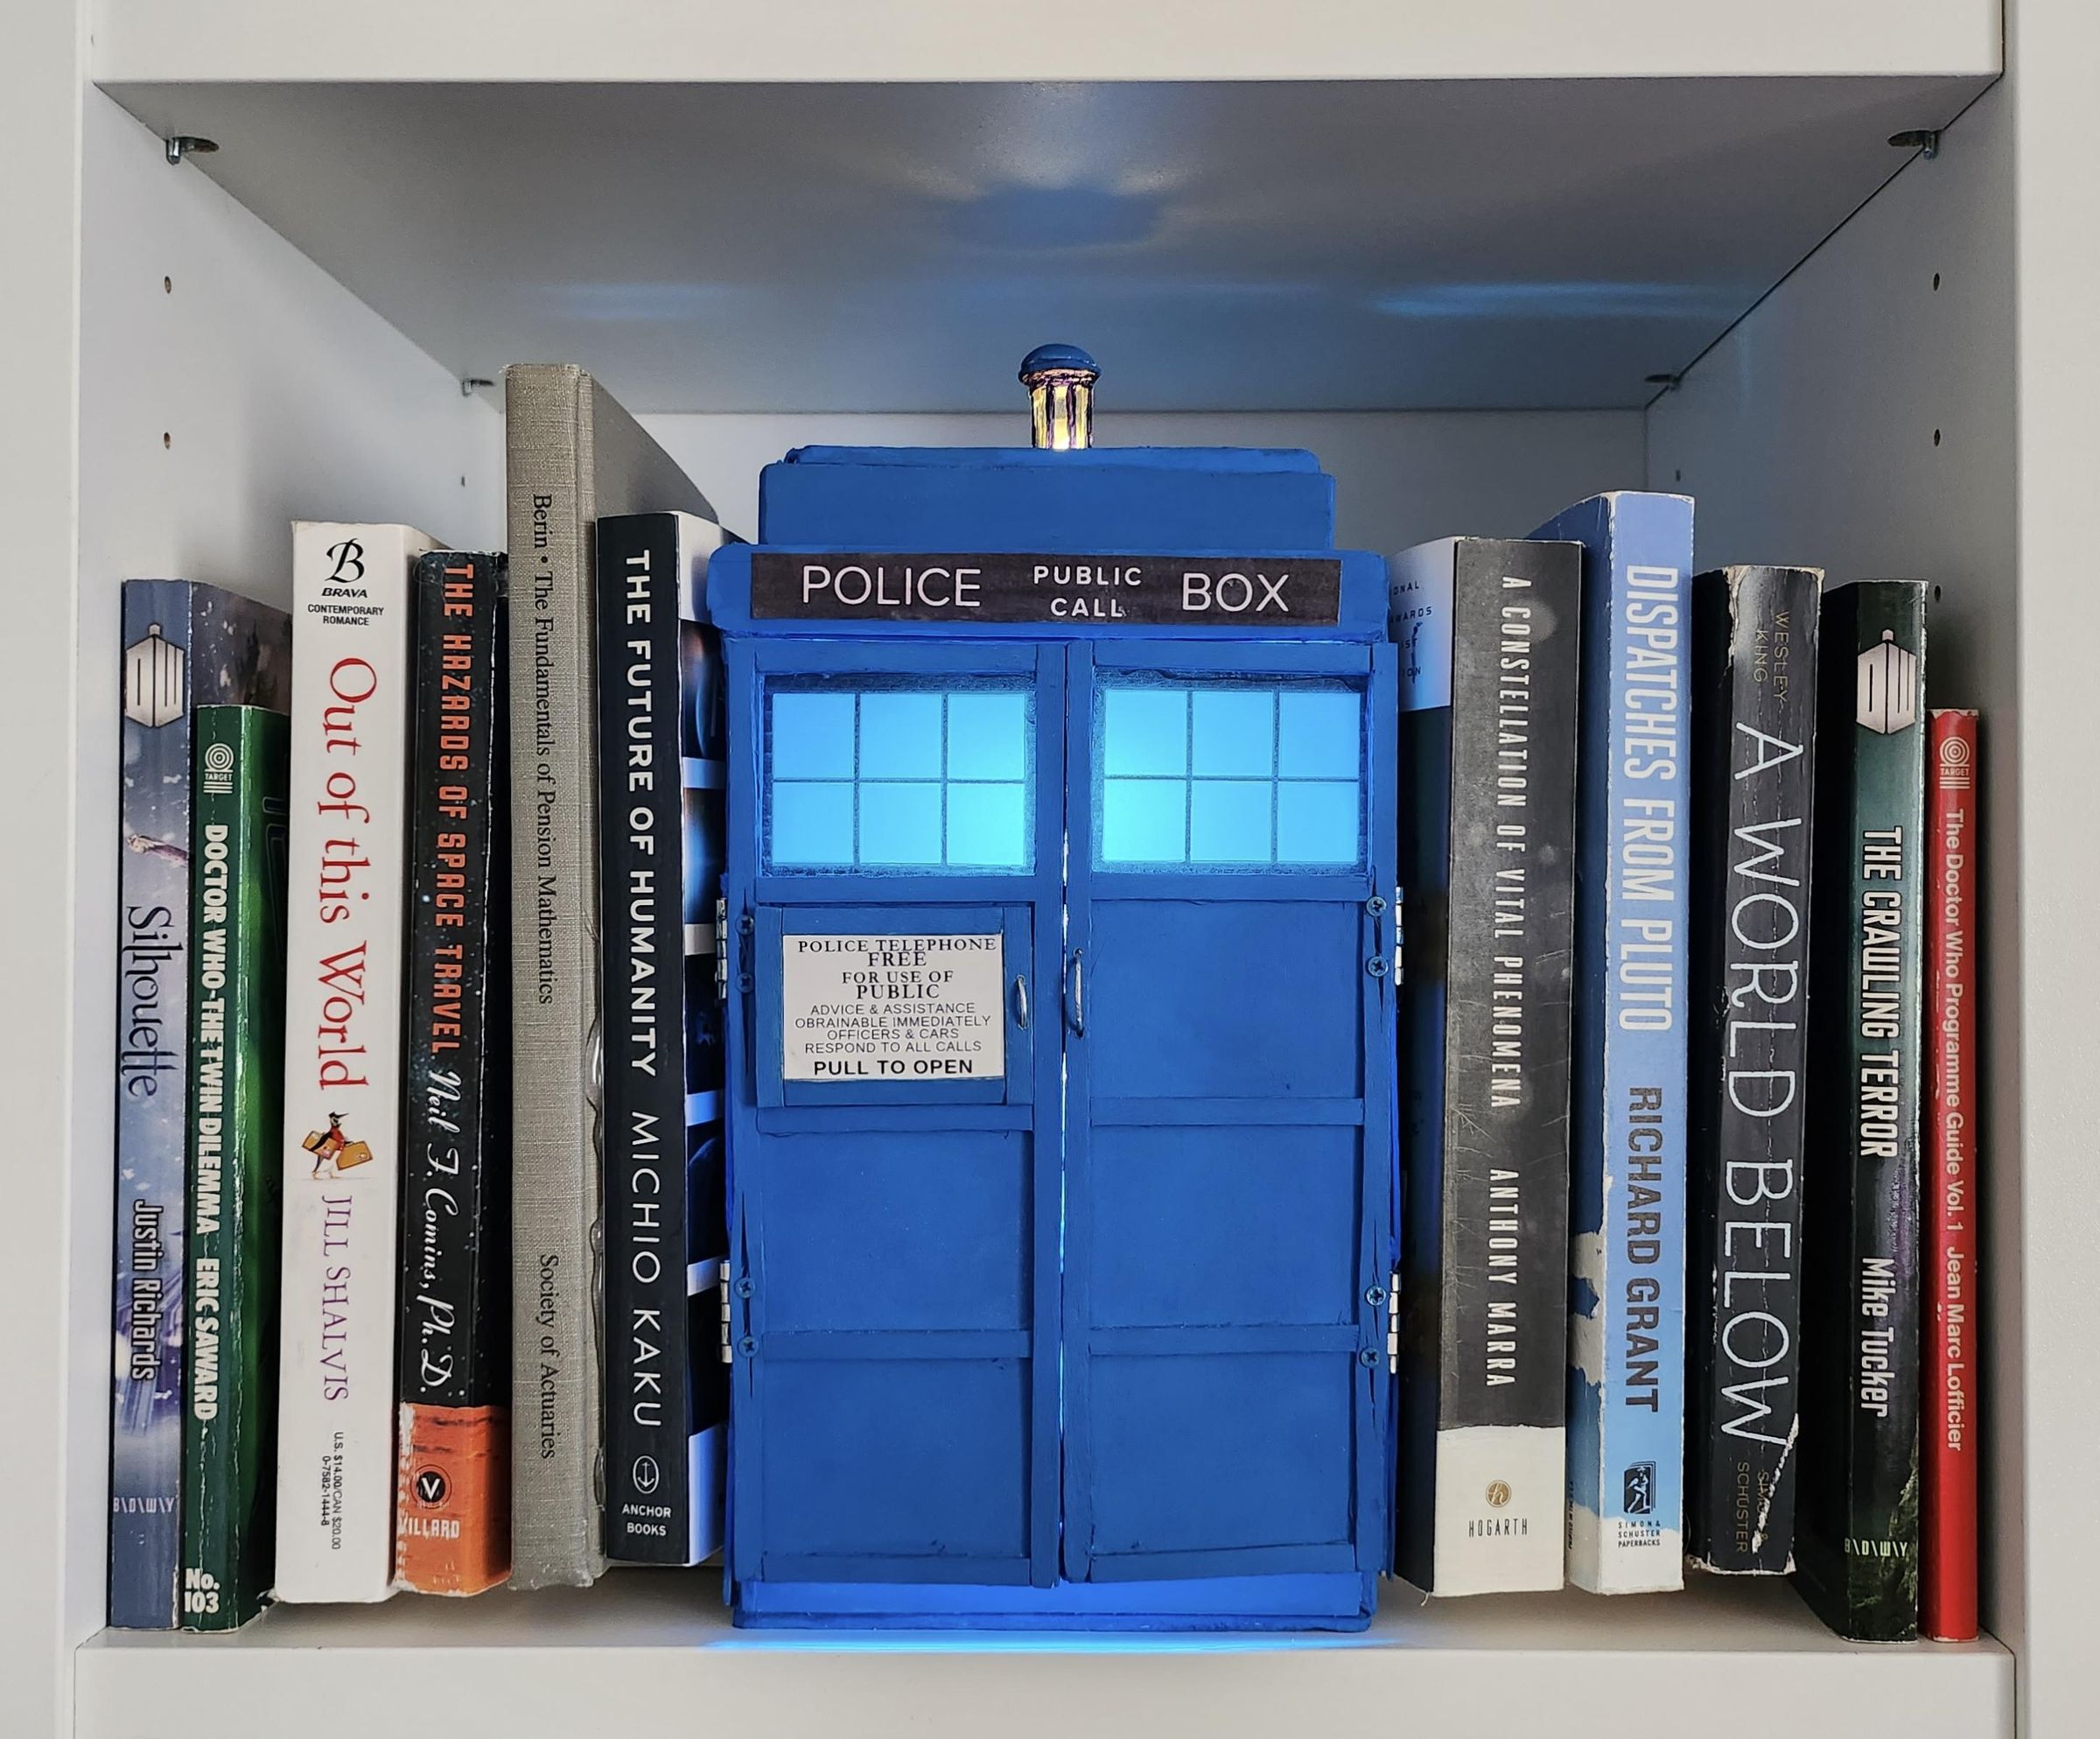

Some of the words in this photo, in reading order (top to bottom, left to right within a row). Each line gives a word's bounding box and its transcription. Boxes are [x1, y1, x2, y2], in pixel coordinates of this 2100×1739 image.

[533, 493, 552, 549] Berin
[321, 587, 368, 599] BRAVA
[444, 563, 474, 618] THE
[535, 571, 554, 611] The
[626, 550, 651, 625] THE
[802, 564, 982, 607] POLICE
[1033, 564, 1143, 586] PUBLIC
[1181, 571, 1291, 613] BOX
[1502, 576, 1531, 589] A
[307, 604, 384, 615] CONTEMPORARY
[323, 615, 369, 626] ROMANCE
[1050, 597, 1125, 618] CALL
[535, 617, 556, 757] Fundamentals
[1623, 564, 1678, 781] DISPATCHES
[1754, 628, 1769, 684] KING
[1773, 610, 1790, 704] WESLEY
[322, 657, 377, 756] Out
[439, 635, 472, 771] HAZARDS
[627, 640, 654, 792] FUTURE
[1497, 607, 1531, 807] CONSTELLATION
[205, 773, 233, 782] TARGET
[536, 761, 556, 787] of
[1734, 722, 1804, 780] A
[1940, 768, 1970, 776] TARGET
[318, 772, 370, 825] of
[438, 786, 467, 821] OF
[537, 790, 557, 868] Pension
[1946, 808, 1964, 850] The
[629, 807, 654, 855] OF
[1495, 824, 1526, 852] OF
[1622, 798, 1675, 901] FROM
[1863, 825, 1903, 880] THE
[203, 824, 229, 923] DOCTOR
[320, 838, 371, 924] this
[436, 833, 466, 928] SPACE
[1494, 869, 1525, 939] VITAL
[1945, 855, 1964, 926] Doctor
[537, 875, 557, 1005] Mathematics
[798, 940, 869, 953] POLICE
[876, 938, 998, 952] TELEPHONE
[867, 951, 928, 968] FREE
[1727, 817, 1802, 1118] WORLD
[1861, 890, 1901, 1039] CRAWLING
[1945, 930, 1964, 979] Who
[122, 905, 185, 1097] Silhouette
[430, 944, 463, 1054] TRAVEL
[630, 870, 656, 1077] HUMANITY
[842, 971, 880, 984] FOR
[886, 971, 921, 984] USE
[928, 970, 954, 983] OF
[857, 984, 941, 999] PUBLIC
[1619, 919, 1673, 1031] PLUTO
[318, 938, 370, 1090] World
[794, 1016, 888, 1029] OBRAINABLE
[892, 1015, 991, 1027] IMMEDIATELY
[810, 1004, 865, 1016] ADVICE
[869, 1004, 878, 1015] &
[883, 1002, 976, 1015] ASSISTANCE
[827, 1028, 900, 1041] OFFICERS
[906, 1028, 914, 1040] &
[919, 1027, 960, 1040] CARS
[1491, 956, 1523, 1108] PHENOMENA
[805, 1042, 876, 1055] RESPOND
[880, 1041, 900, 1053] TO
[906, 1041, 931, 1052] ALL
[935, 1041, 982, 1052] CALLS
[814, 1060, 870, 1076] PULL
[877, 1060, 906, 1075] TO
[914, 1059, 973, 1075] OPEN
[1942, 984, 1964, 1108] Programme
[199, 1047, 225, 1112] TWIN
[428, 1069, 463, 1134] Neil
[1860, 1049, 1900, 1158] TERROR
[1945, 1112, 1964, 1175] Guide
[196, 1118, 224, 1235] DILEMMA
[632, 1110, 661, 1285] MICHIO
[1627, 1087, 1662, 1265] RICHARD
[1946, 1180, 1964, 1219] Vol.
[132, 1198, 164, 1271] Justin
[322, 1194, 353, 1258] JILL
[418, 1187, 459, 1289] Comins,
[1488, 1168, 1520, 1285] ANTHONY
[1947, 1222, 1964, 1231] 1
[194, 1257, 220, 1313] ERIC
[536, 1253, 560, 1329] Society
[1720, 1158, 1794, 1446] BELOW
[1861, 1256, 1897, 1319] Mike
[1946, 1245, 1965, 1299] Jean
[131, 1277, 162, 1381] Richards
[319, 1266, 351, 1401] SHALVIS
[539, 1335, 560, 1358] of
[1486, 1301, 1517, 1387] MARRA
[1625, 1277, 1661, 1413] GRANT
[1946, 1303, 1965, 1359] Marc
[192, 1315, 220, 1421] SAWARD
[633, 1308, 662, 1427] KAKU
[1860, 1326, 1895, 1418] Tucker
[539, 1362, 560, 1460] Actuaries
[1946, 1363, 1965, 1452] Lofficier
[333, 1431, 344, 1452] U.S.
[320, 1455, 332, 1526] 0-7582-1444-8
[622, 1503, 672, 1518] ANCHOR
[1736, 1462, 1749, 1554] SCHUSTER
[331, 1516, 342, 1550] $20.00
[626, 1522, 667, 1537] BOOKS
[1468, 1518, 1528, 1538] HOGARTH
[1618, 1520, 1653, 1529] SIMON
[1618, 1529, 1661, 1539] SCHUSTER
[1618, 1539, 1661, 1548] PAPERBACKS
[184, 1590, 220, 1614] 103
[185, 1567, 220, 1590] No.
